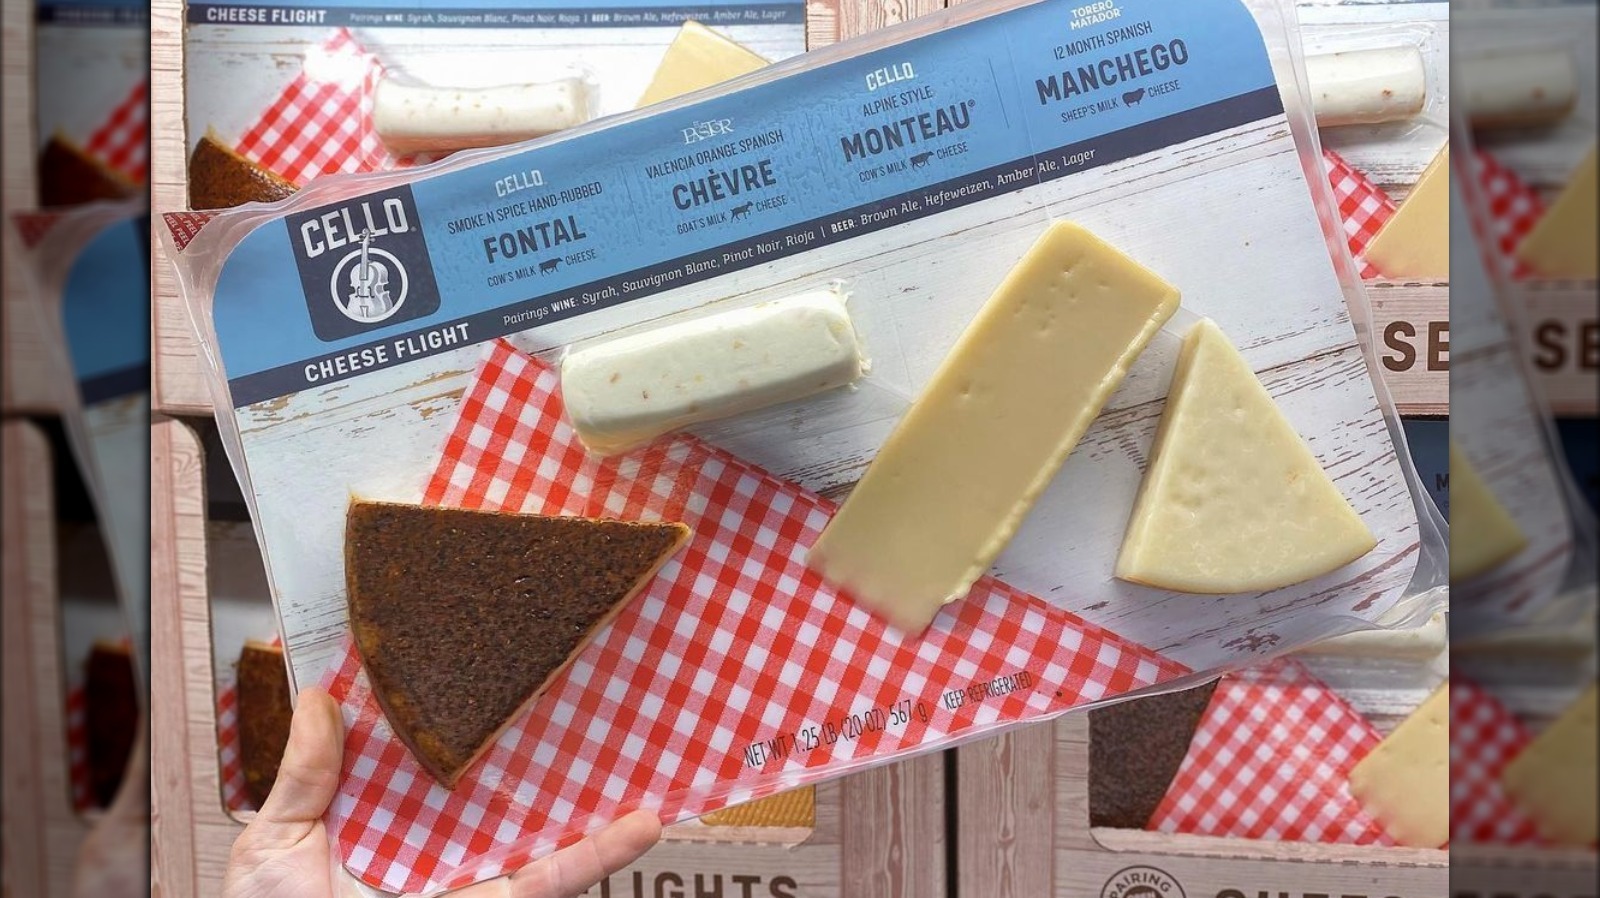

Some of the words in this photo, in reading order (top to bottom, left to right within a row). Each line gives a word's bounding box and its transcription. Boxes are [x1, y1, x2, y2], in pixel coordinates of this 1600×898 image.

[206, 7, 267, 22] CHEESE
[271, 9, 327, 24] FLIGHT
[1070, 8, 1121, 30] MATADOR
[1071, 0, 1114, 18] TORERO
[1053, 47, 1064, 60] 12
[1065, 35, 1106, 57] MONTH
[1105, 20, 1153, 46] SPANISH
[866, 62, 915, 91] CELLO
[1035, 38, 1189, 105] MANCHEGO
[863, 95, 899, 117] ALPINE
[900, 85, 933, 106] STYLE
[1061, 104, 1097, 123] SHEEP'S
[1097, 97, 1119, 114] MILK
[1148, 79, 1181, 98] CHEESE
[682, 119, 734, 145] PASTOR
[645, 156, 695, 179] VALENCIA
[697, 142, 738, 165] ORANGE
[739, 129, 785, 152] SPANISH
[858, 167, 885, 183] COW'S
[886, 159, 907, 175] MILK
[936, 142, 969, 160] CHEESE
[495, 169, 544, 197] CELLO
[672, 159, 777, 211] CHÈVRE
[301, 198, 409, 259] CELLO
[447, 214, 485, 235] SMOKE
[487, 211, 496, 224] N
[497, 202, 528, 222] SPICE
[529, 182, 603, 214] HAND-RUBBED
[677, 218, 705, 234] GOAT'S
[707, 211, 727, 226] MILK
[756, 195, 788, 212] CHEESE
[484, 215, 586, 264] FONTAL
[503, 306, 549, 326] Pairings
[550, 297, 579, 313] WINE:
[581, 286, 620, 306] Syrah,
[622, 267, 683, 294] Sauvignon
[685, 257, 721, 276] Blanc,
[723, 247, 755, 265] Pinot
[756, 240, 784, 257] Noir,
[786, 230, 815, 248] Rioja
[830, 218, 858, 234] BEER:
[860, 206, 898, 225] Brown
[900, 197, 923, 214] Ale,
[925, 179, 995, 207] Hefeweizen,
[997, 166, 1035, 186] Amber
[1037, 160, 1061, 174] Ale,
[1062, 149, 1097, 168] Lager
[487, 272, 514, 288] COW'S
[515, 266, 537, 281] MILK
[565, 249, 597, 266] CHEESE
[304, 351, 389, 383] CHEESE
[395, 322, 470, 359] FLIGHT
[743, 744, 767, 768] NET
[768, 739, 789, 761] WT
[791, 725, 820, 754] 1.25
[821, 721, 838, 745] LB
[841, 714, 863, 742] (20
[865, 709, 888, 733] OZ)
[890, 700, 914, 726] 567
[918, 702, 928, 722] g
[943, 690, 967, 711] KEEP
[969, 671, 1033, 703] REFRIGERATED
